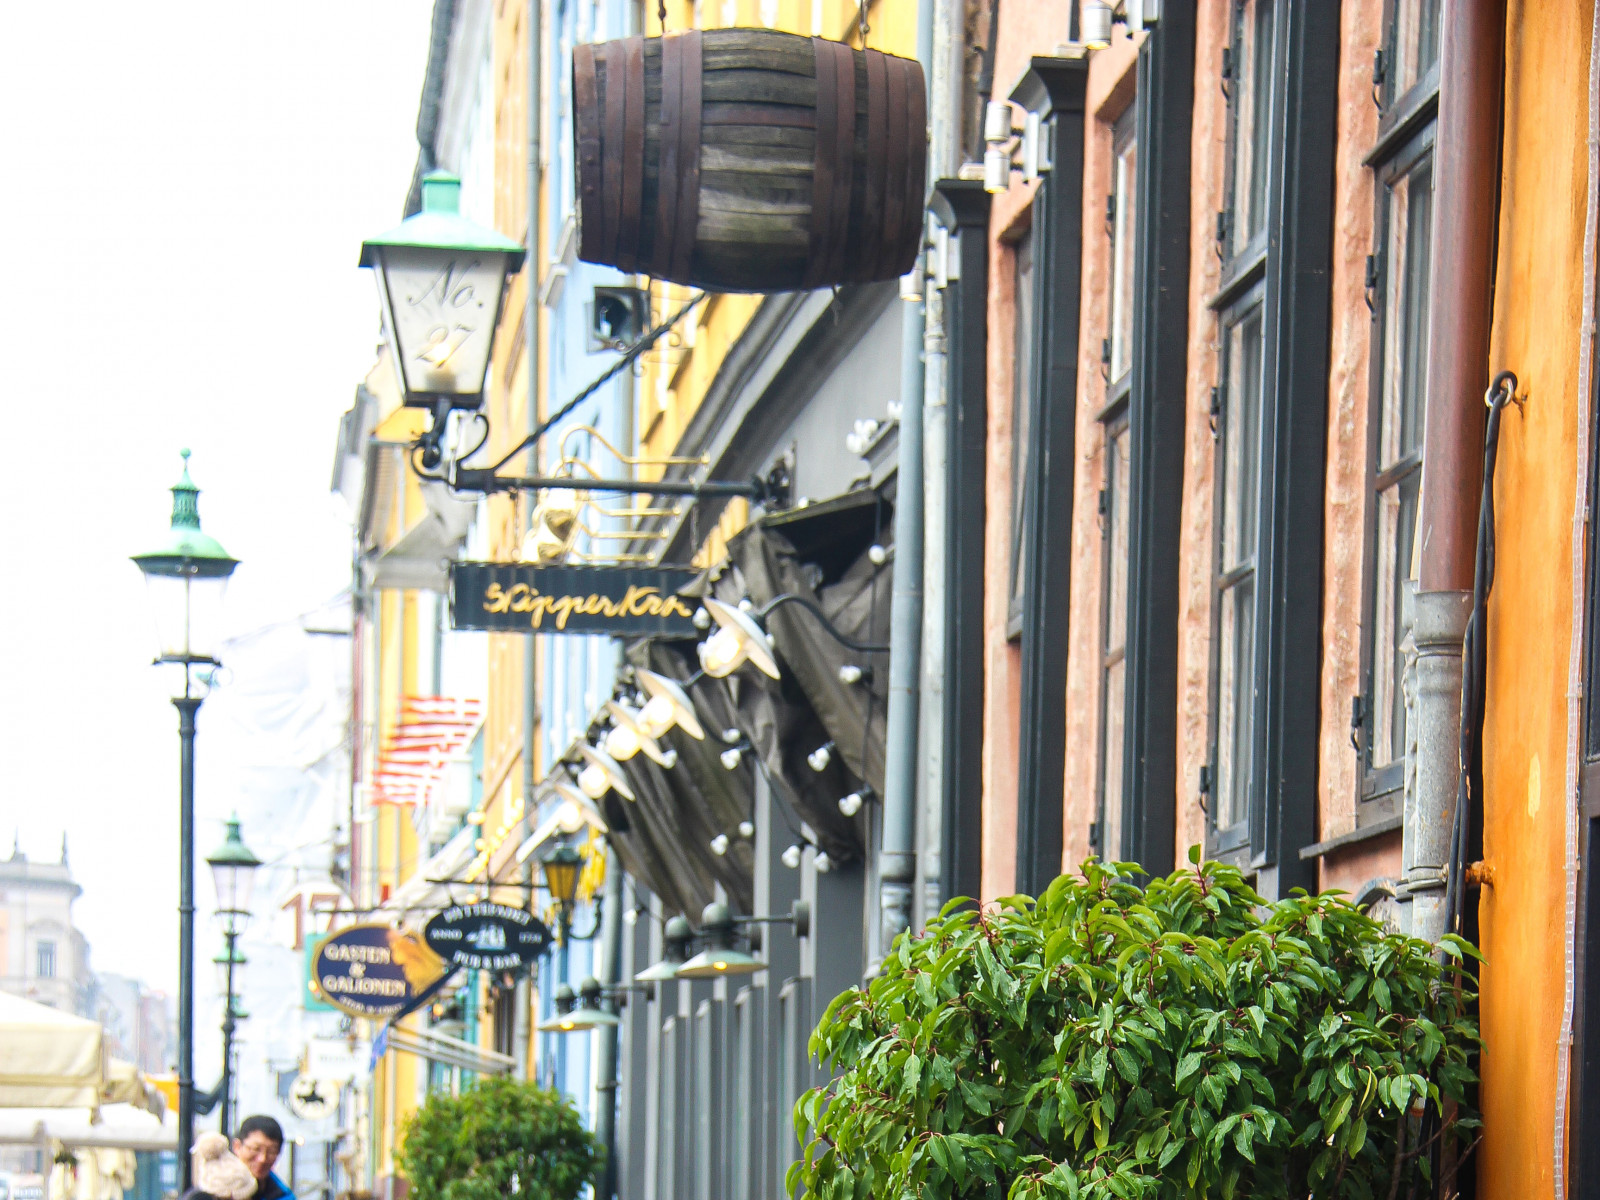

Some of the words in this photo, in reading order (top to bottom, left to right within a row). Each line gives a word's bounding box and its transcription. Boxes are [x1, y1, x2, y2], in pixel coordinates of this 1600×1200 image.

[415, 323, 477, 369] 27
[324, 943, 391, 965] GASTEN
[349, 961, 367, 978] &
[322, 974, 407, 997] GALIONEN
